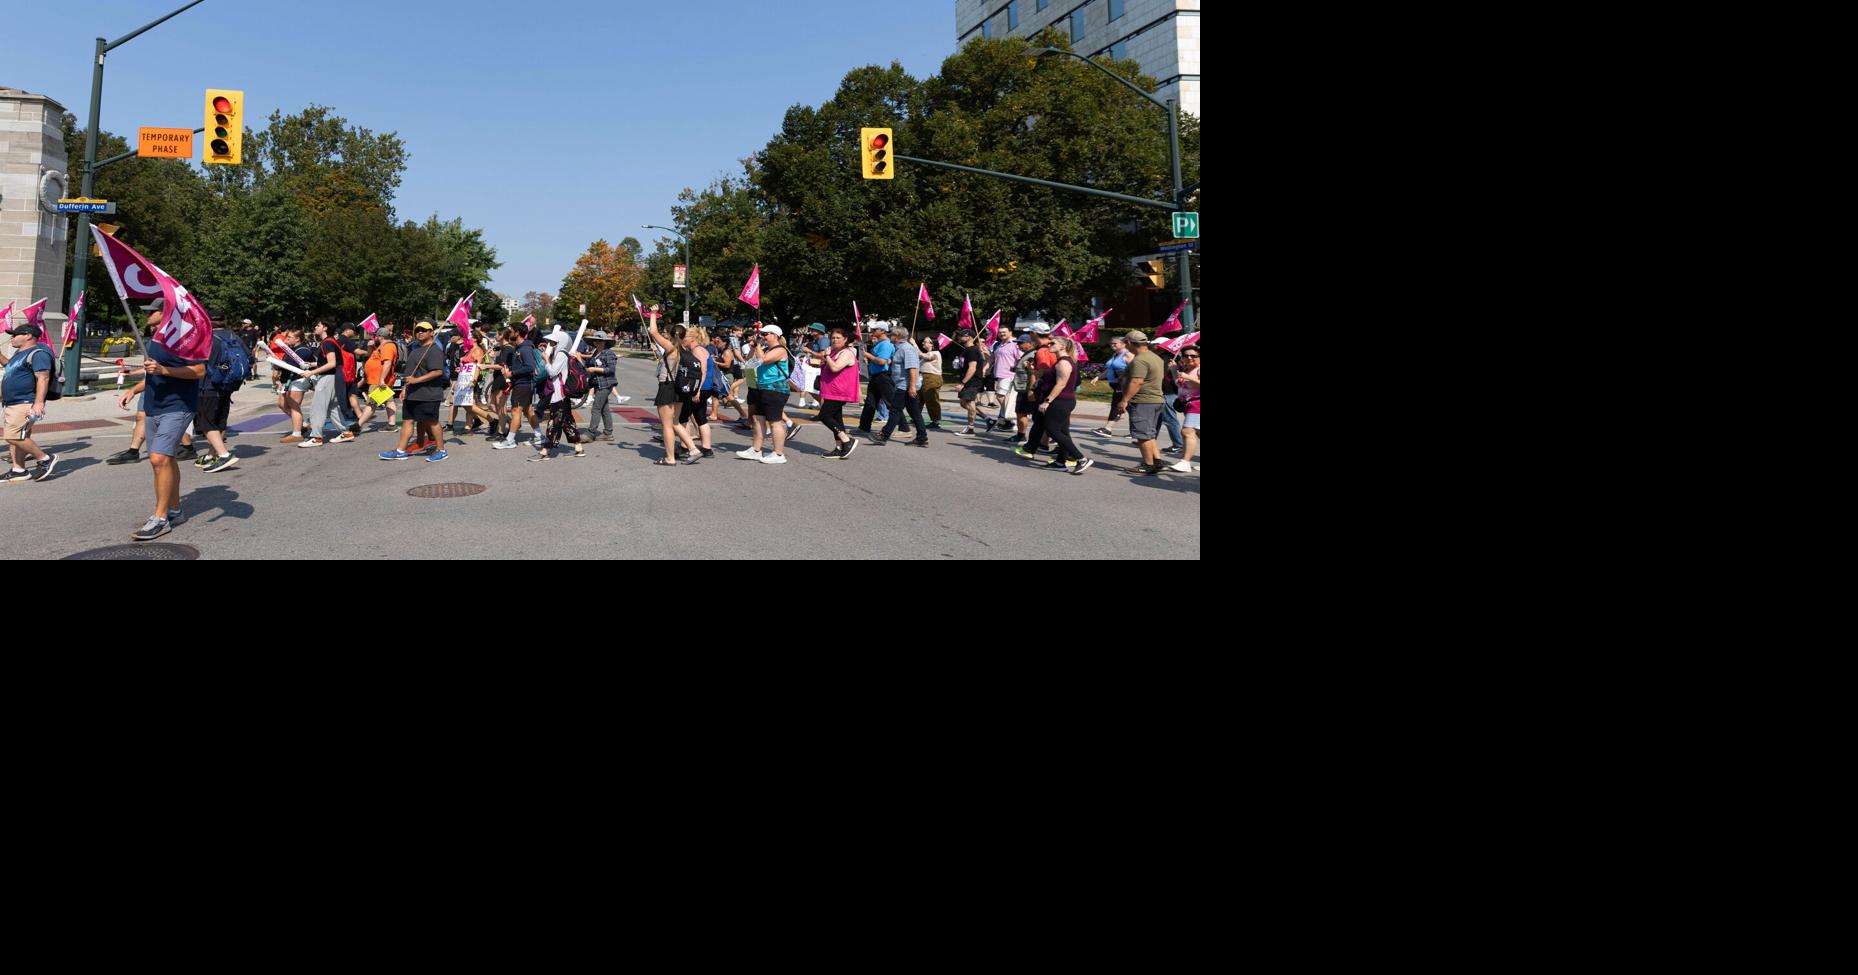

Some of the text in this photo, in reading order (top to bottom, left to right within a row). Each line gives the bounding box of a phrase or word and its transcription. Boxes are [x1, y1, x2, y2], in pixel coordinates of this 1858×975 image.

[142, 133, 190, 143] TEMPORARY
[152, 145, 178, 154] PHASE
[1176, 216, 1189, 233] P
